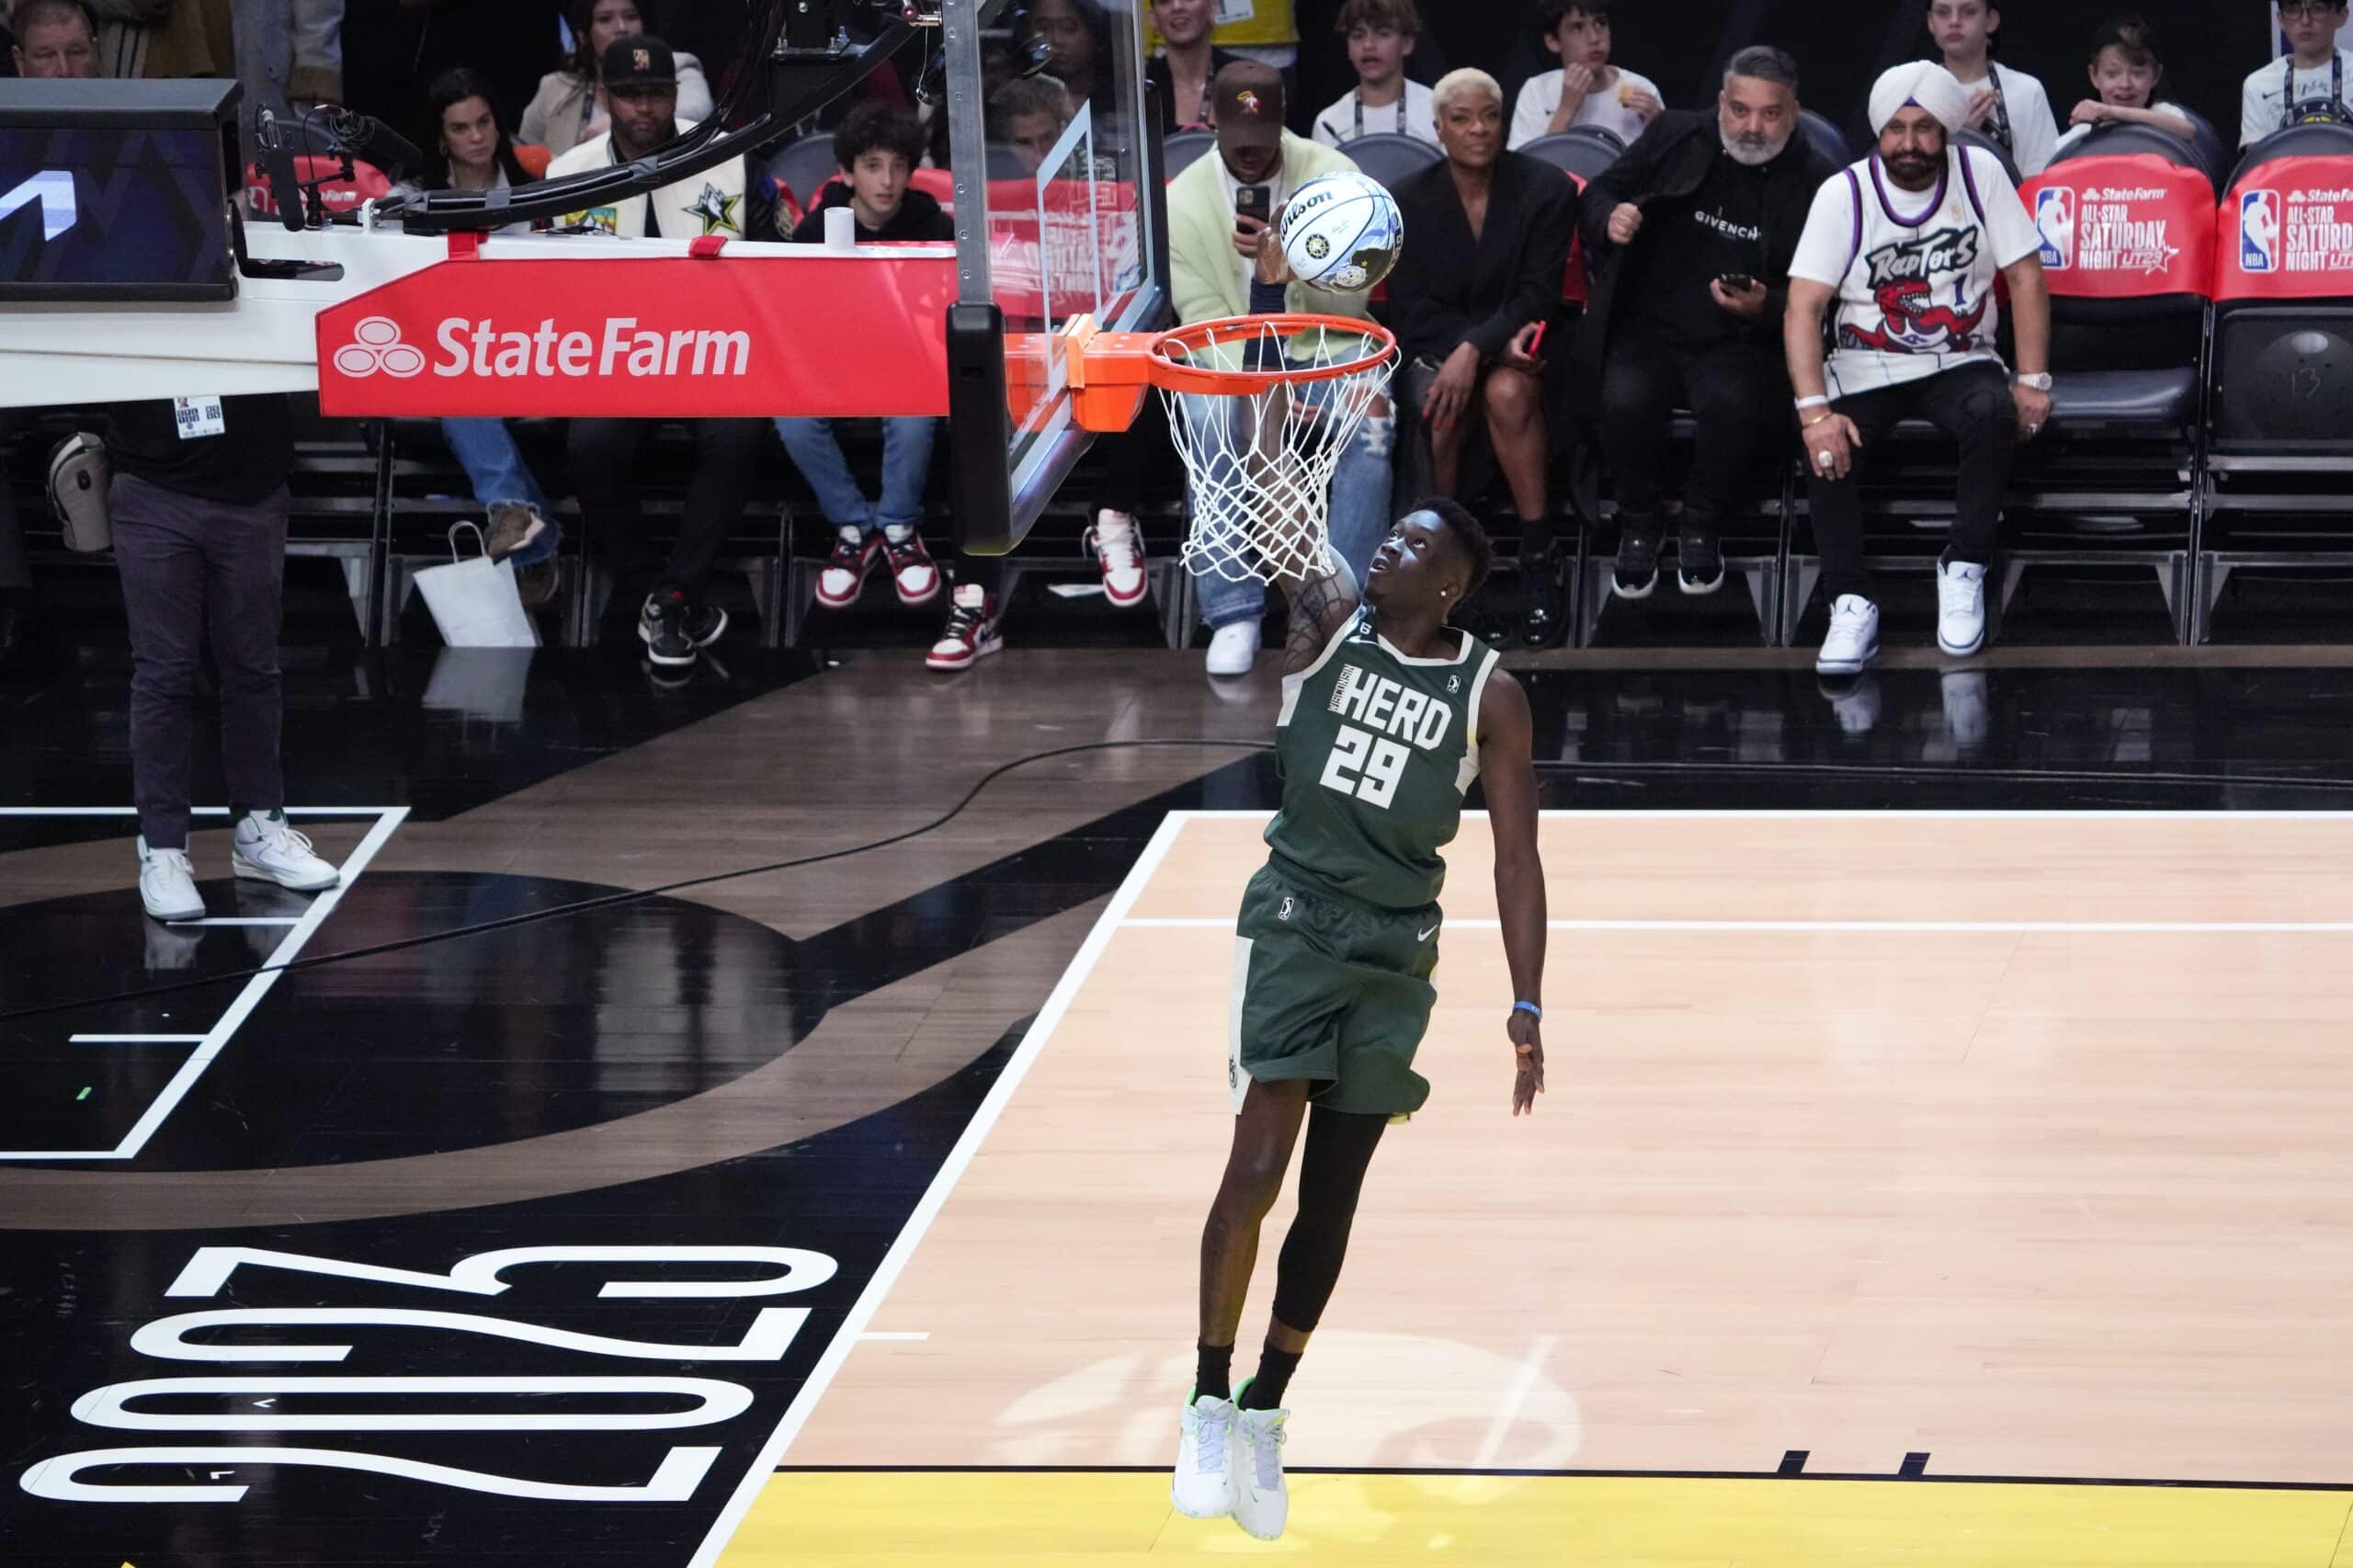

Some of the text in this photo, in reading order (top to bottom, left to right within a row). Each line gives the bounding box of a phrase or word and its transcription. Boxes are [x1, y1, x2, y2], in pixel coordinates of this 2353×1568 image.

[1695, 210, 1762, 241] GIVENCH
[2079, 221, 2166, 251] SATURDAY
[2078, 249, 2122, 269] NIGHT
[2245, 252, 2264, 267] NBA
[2285, 250, 2328, 271] NIGHT
[1953, 274, 1968, 307] 1
[1327, 664, 1356, 711] WISCONSIN
[1329, 664, 1453, 751] HERD
[1319, 724, 1412, 809] 29
